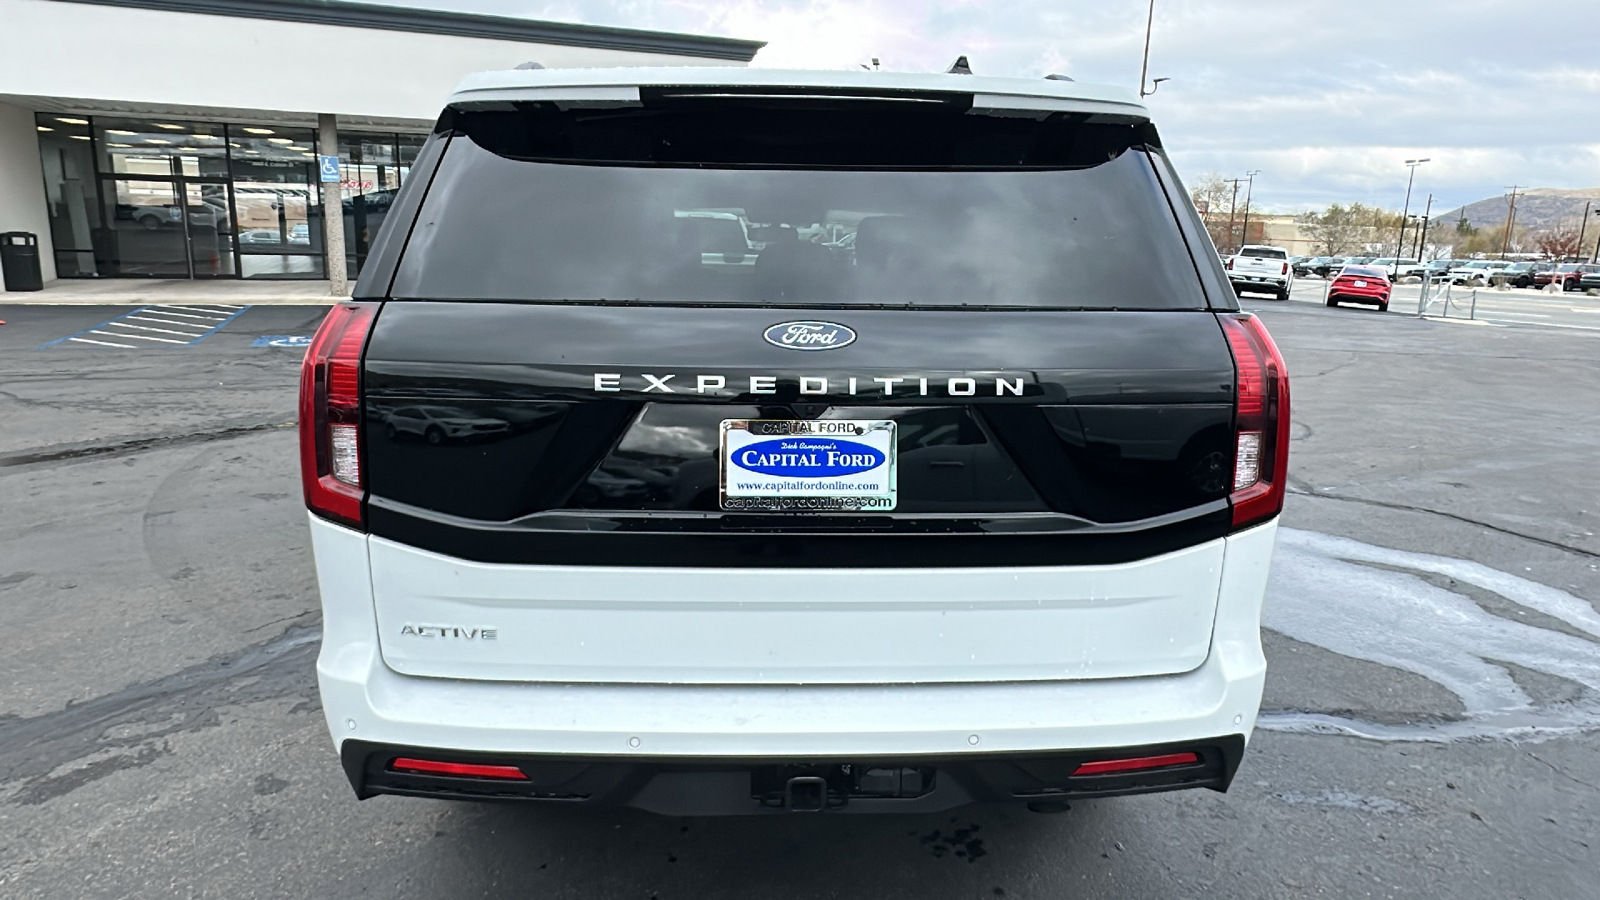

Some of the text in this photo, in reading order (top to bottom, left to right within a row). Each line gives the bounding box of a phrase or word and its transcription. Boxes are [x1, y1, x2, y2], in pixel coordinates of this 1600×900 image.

[782, 325, 838, 344] Ford
[594, 373, 1025, 396] EXPEDITION
[762, 423, 856, 434] CAPITAL FORD
[737, 481, 879, 492] www.capitalfordonline.com
[401, 623, 497, 639] ACTIVE
